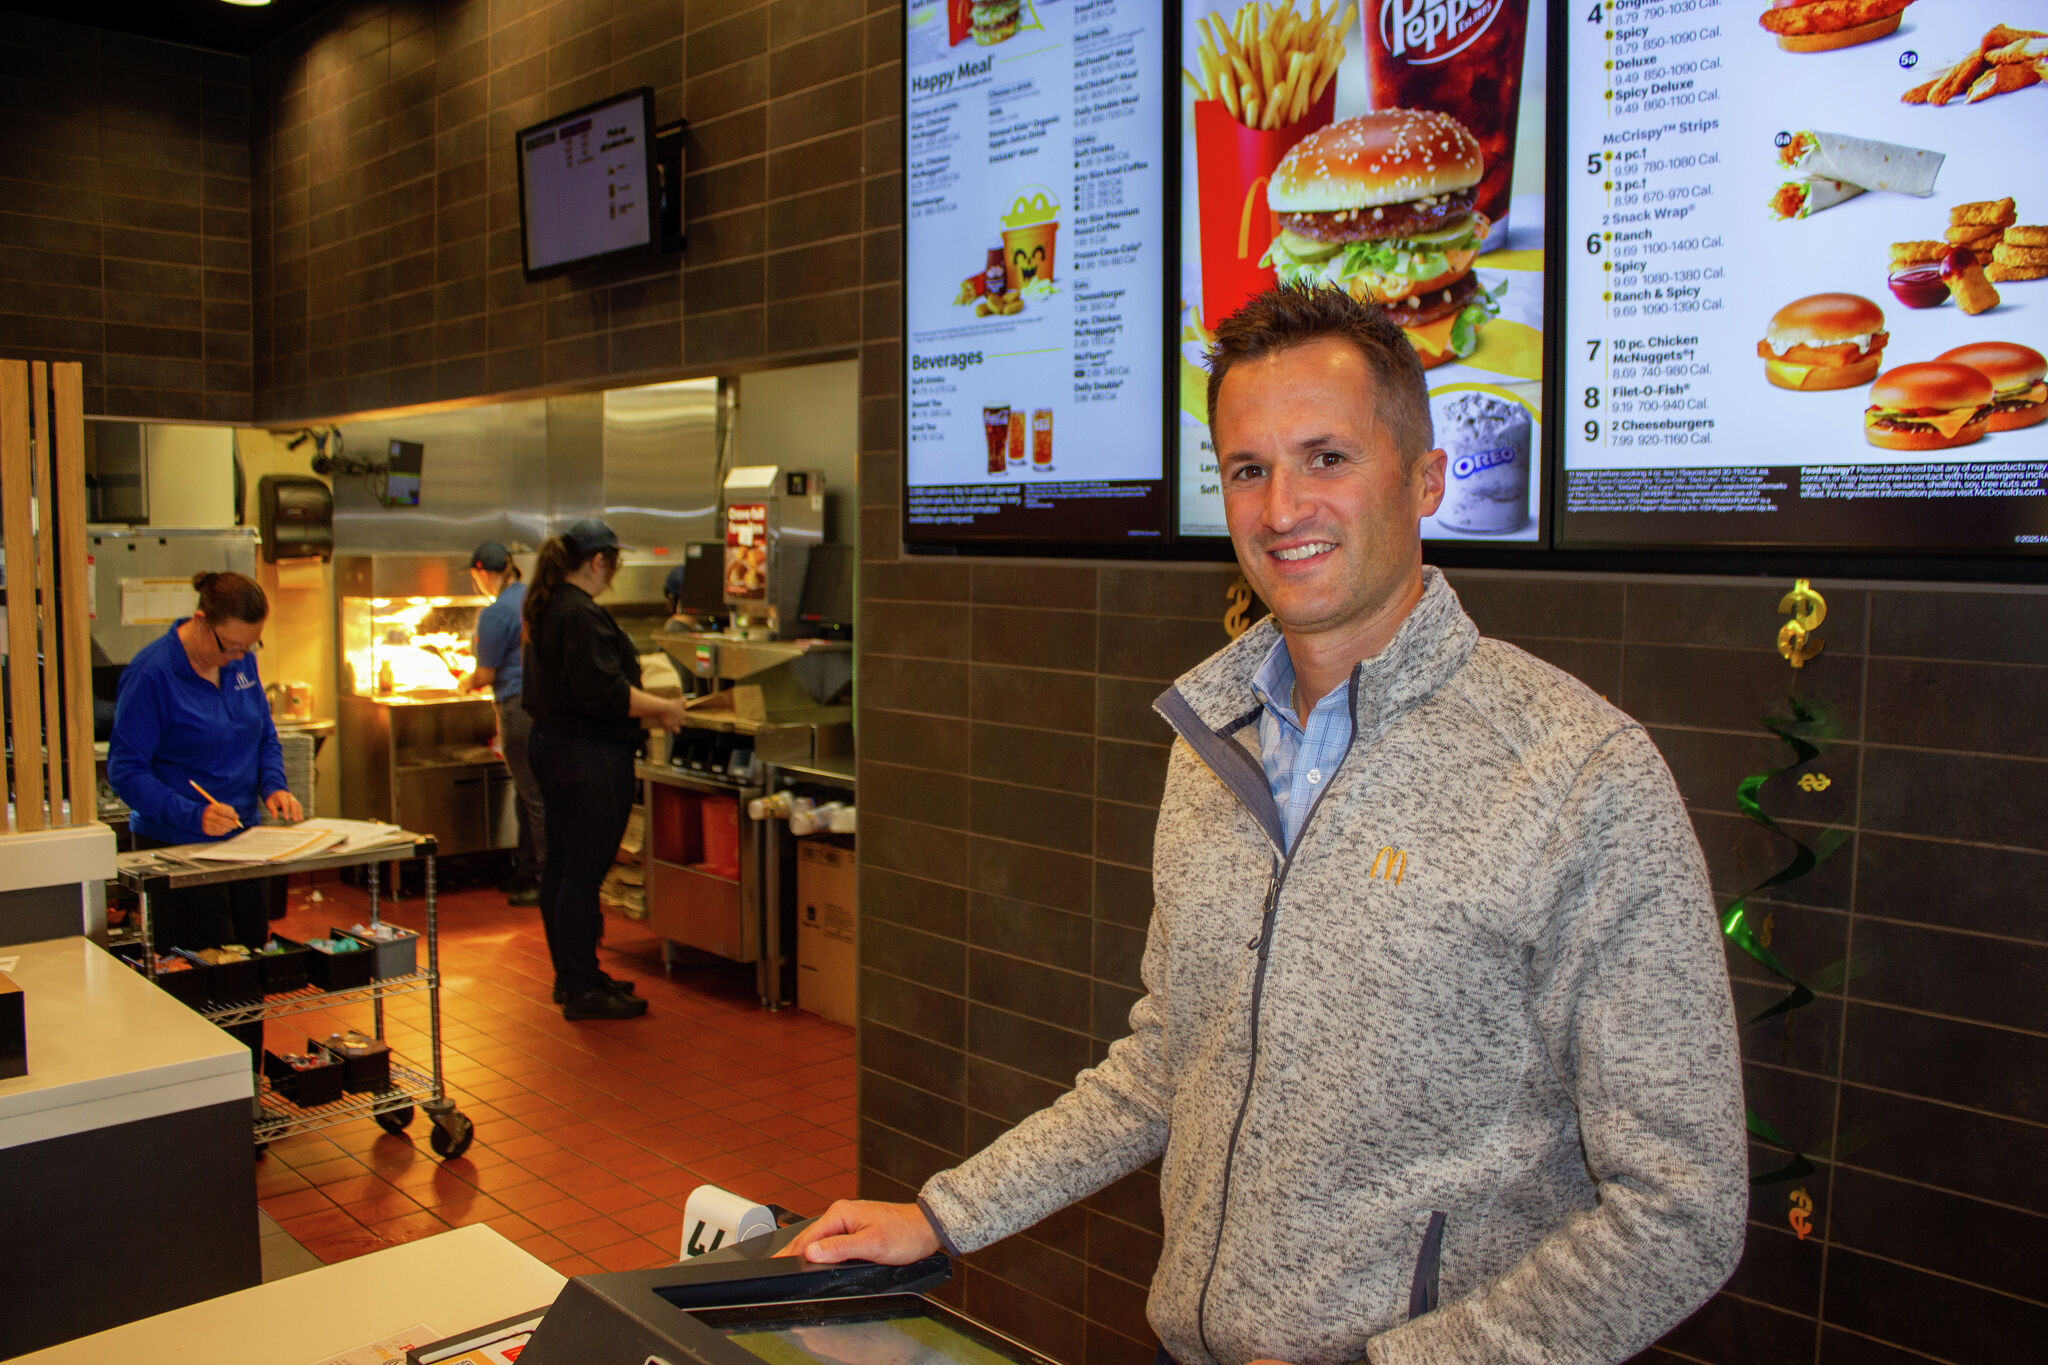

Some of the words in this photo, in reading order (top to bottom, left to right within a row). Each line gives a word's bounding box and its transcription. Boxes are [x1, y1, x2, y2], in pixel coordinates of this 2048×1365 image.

[1587, 3, 1603, 24] 4
[1616, 12, 1638, 26] 8.79
[1644, 1, 1696, 20] 790-1030
[1616, 27, 1648, 42] Spicy
[1616, 42, 1638, 56] 8.79
[1643, 31, 1697, 50] 850-1090
[1700, 26, 1722, 40] Cal.
[1616, 56, 1657, 70] Deluxe
[1901, 53, 1917, 66] 5a
[912, 70, 954, 92] Happy
[1616, 72, 1639, 86] 9.49
[1644, 62, 1697, 80] 850-1090
[1700, 57, 1722, 71] Cal.
[1616, 87, 1648, 102] Spicy
[1652, 80, 1694, 94] Deluxe
[1615, 102, 1638, 116] 9.49
[1644, 93, 1696, 112] 860-1100
[1698, 88, 1720, 102] Cal.
[1680, 118, 1719, 134] Strips
[1776, 134, 1791, 146] 6a
[1123, 162, 1148, 173] Coffee
[1587, 152, 1602, 174] 5
[1615, 152, 1622, 160] 4
[1615, 163, 1638, 177] 9.99
[1699, 152, 1721, 165] Cal.
[1615, 182, 1622, 191] 3
[1644, 187, 1690, 204] 670-970
[1692, 184, 1714, 197] Cal.
[1602, 215, 1610, 226] 2
[1612, 209, 1651, 224] Snack
[1586, 233, 1602, 255] 6
[1615, 228, 1652, 242] Ranch
[1614, 245, 1638, 258] 9.69
[1643, 239, 1699, 254] 1100-1400
[1702, 236, 1724, 248] Cal.
[1614, 260, 1647, 274] Spicy
[1614, 275, 1638, 288] 9.69
[1704, 266, 1725, 280] Cal.
[1614, 290, 1652, 302] Ranch
[1655, 289, 1662, 298] &
[1666, 284, 1700, 299] Spicy
[1614, 306, 1637, 318] 9.69
[1642, 300, 1700, 315] 1090-1390
[1702, 298, 1724, 311] Cal.
[1586, 340, 1601, 361] 7
[1614, 340, 1626, 350] 10
[1628, 340, 1645, 352] pc.
[1648, 336, 1698, 348] Chicken
[912, 350, 983, 371] Beverages
[1613, 368, 1636, 380] 8.69
[1642, 364, 1688, 377] 740-980
[1690, 364, 1712, 376] Cal.
[1584, 387, 1600, 408] 8
[1612, 402, 1633, 412] 9.19
[1639, 399, 1684, 412] 700-940
[1687, 398, 1708, 410] Cal.
[1584, 420, 1600, 442] 9
[1612, 421, 1619, 431] 2
[1622, 418, 1714, 432] Cheeseburgers
[1690, 432, 1712, 444] Cal.
[1200, 464, 1219, 474] Larg
[1453, 448, 1515, 479] OREO
[1801, 466, 1822, 475] Food
[1822, 466, 1856, 476] Allergy?
[1857, 465, 1882, 474] Please
[1884, 465, 1894, 474] be
[1896, 464, 1927, 474] advised
[1928, 464, 1944, 472] that
[1945, 464, 1961, 474] any
[1962, 464, 1972, 472] of
[1972, 464, 1986, 472] our
[1987, 462, 2027, 473] products
[2028, 463, 2048, 472] may
[1842, 475, 1858, 483] may
[1860, 474, 1879, 482] have
[1904, 473, 1912, 481] in
[1912, 473, 1944, 481] contact
[1944, 472, 1964, 480] with
[1964, 472, 1985, 480] food
[1986, 472, 2025, 481] allergens
[2026, 471, 2048, 479] inclu
[1982, 480, 2000, 488] tree
[2000, 480, 2020, 488] nuts
[2020, 480, 2039, 488] and
[1201, 484, 1219, 494] Soft
[1826, 490, 1840, 498] For
[1840, 490, 1880, 500] ingredient
[1880, 489, 1928, 498] information
[1928, 490, 1956, 498] please
[1956, 489, 1974, 497] visit
